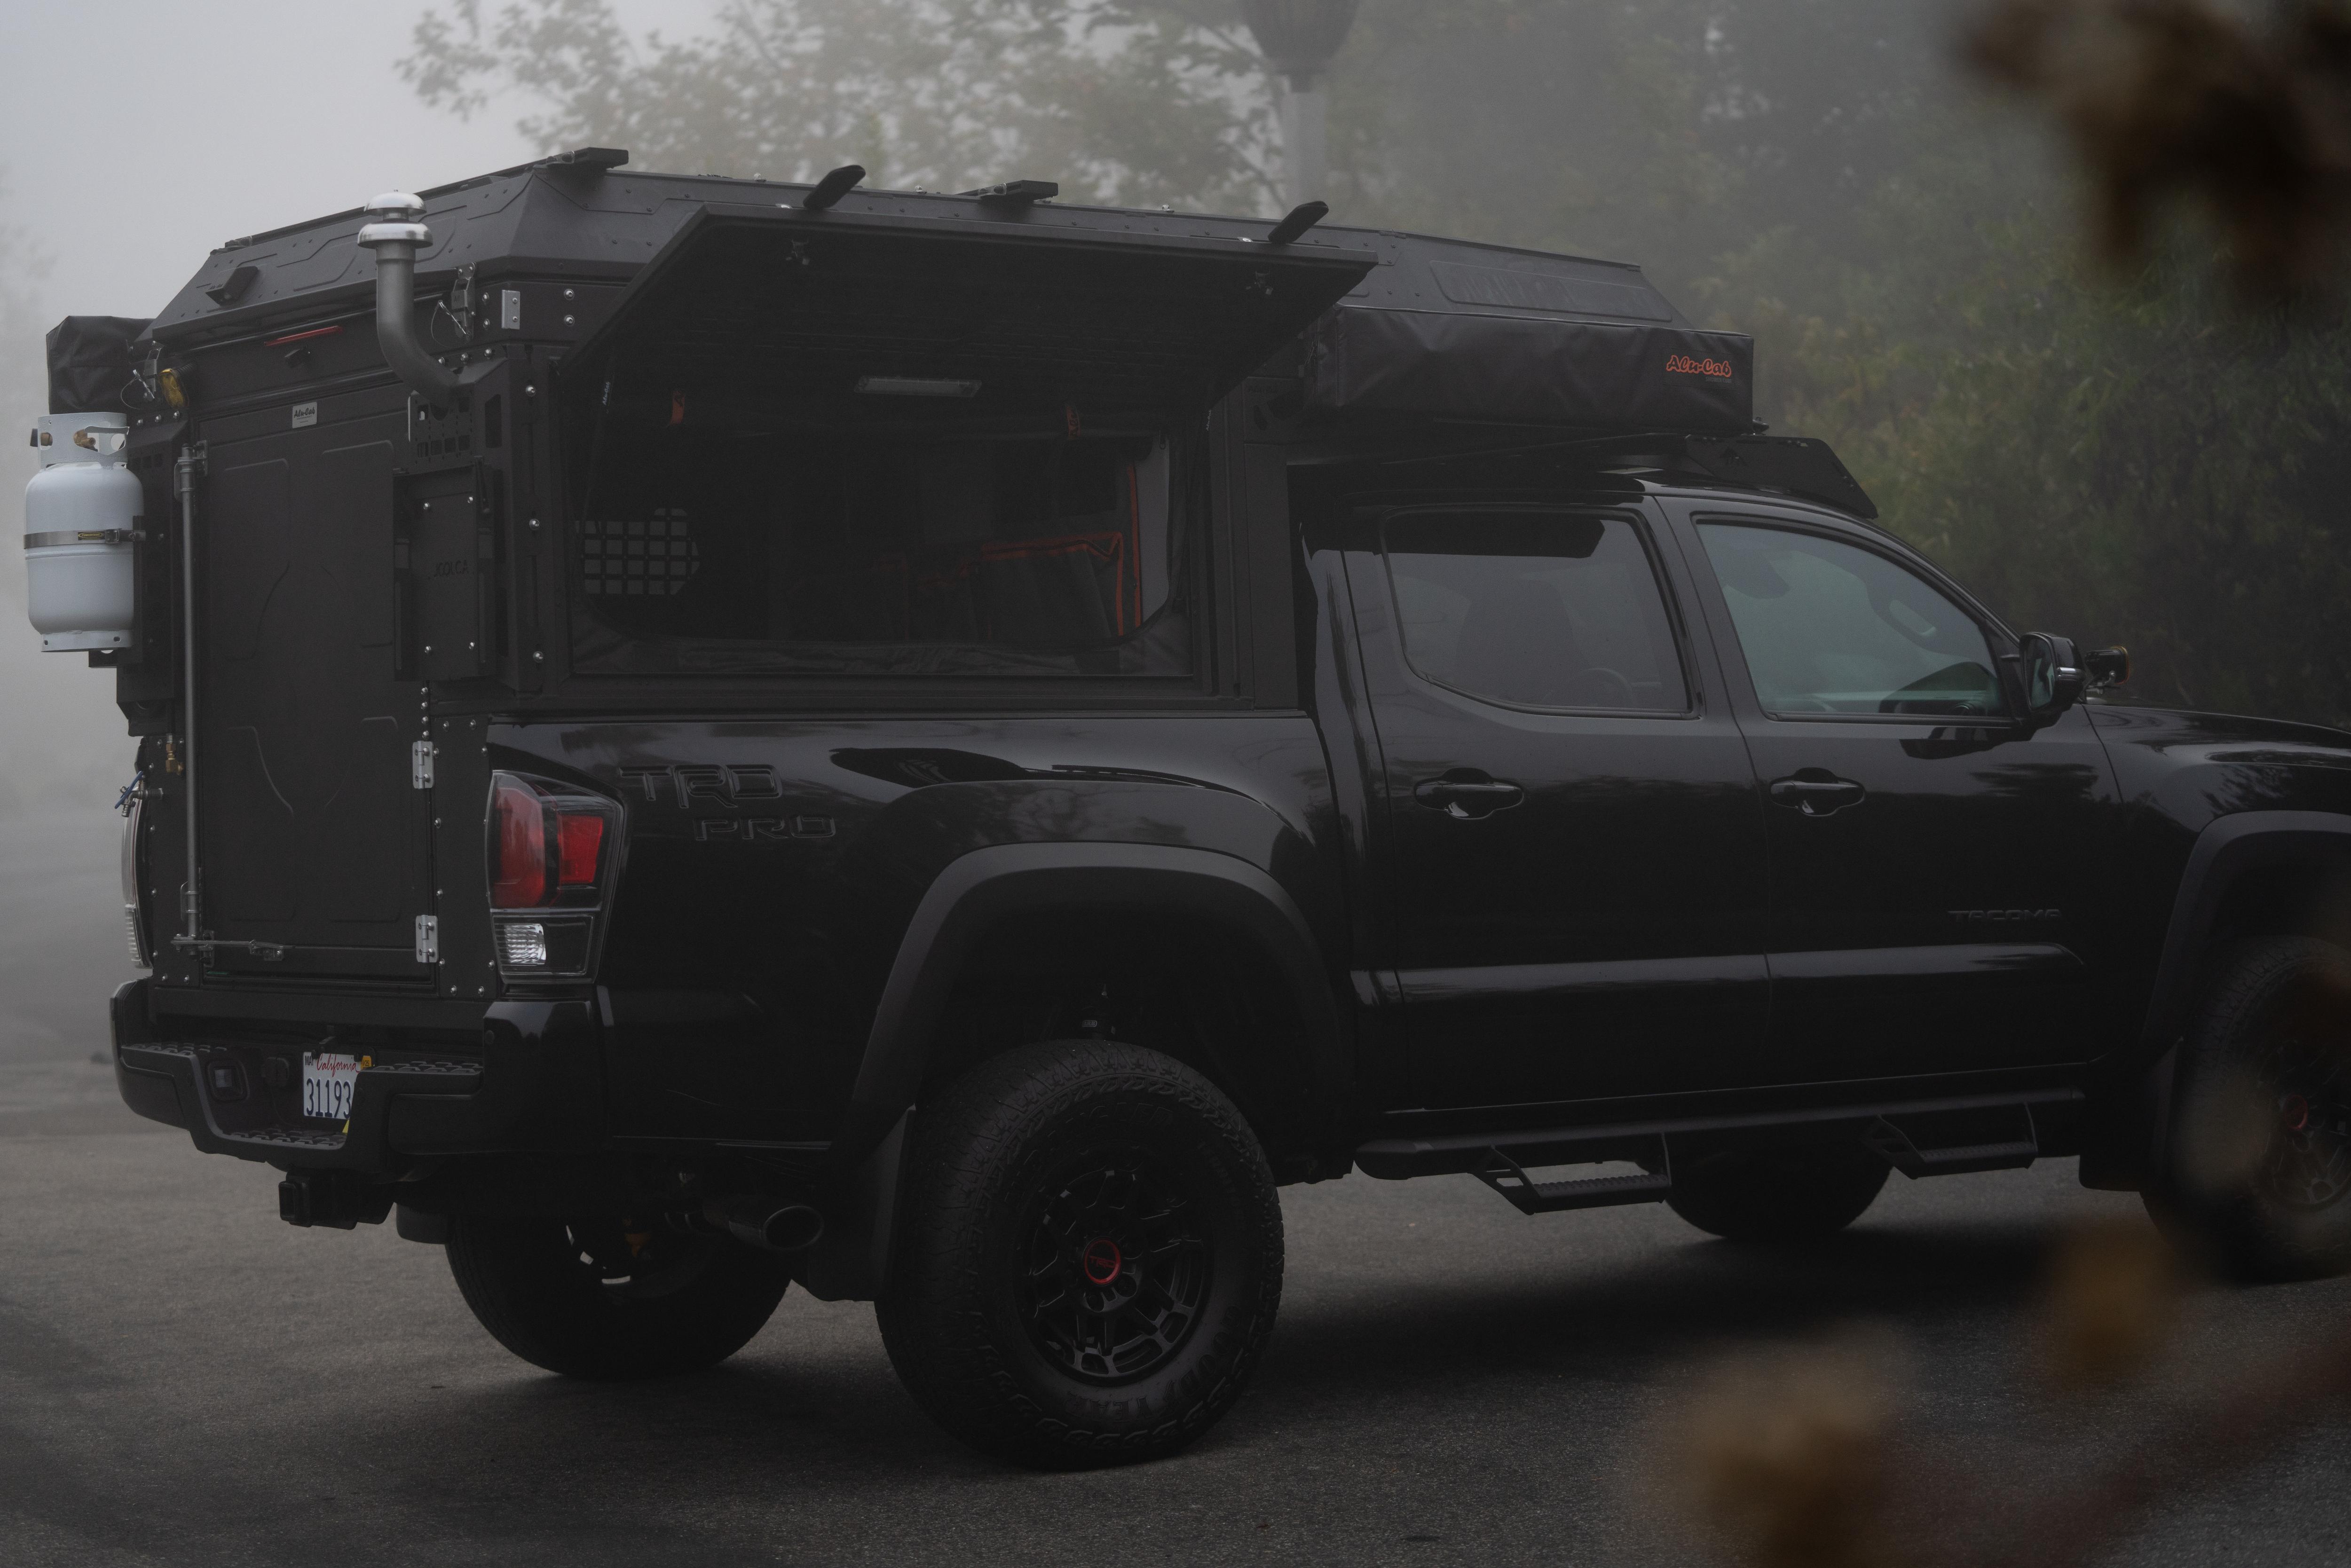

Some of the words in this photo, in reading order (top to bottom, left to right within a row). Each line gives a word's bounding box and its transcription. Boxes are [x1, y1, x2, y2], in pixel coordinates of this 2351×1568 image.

[1666, 355, 1731, 378] Alu-Cab
[294, 407, 316, 418] Alu-Cab
[617, 764, 783, 809] TRD
[693, 814, 836, 841] PRO
[1947, 908, 2062, 922] TACOMA
[317, 1053, 360, 1077] California
[306, 1078, 351, 1119] 31193
[1089, 1256, 1117, 1269] TRD
